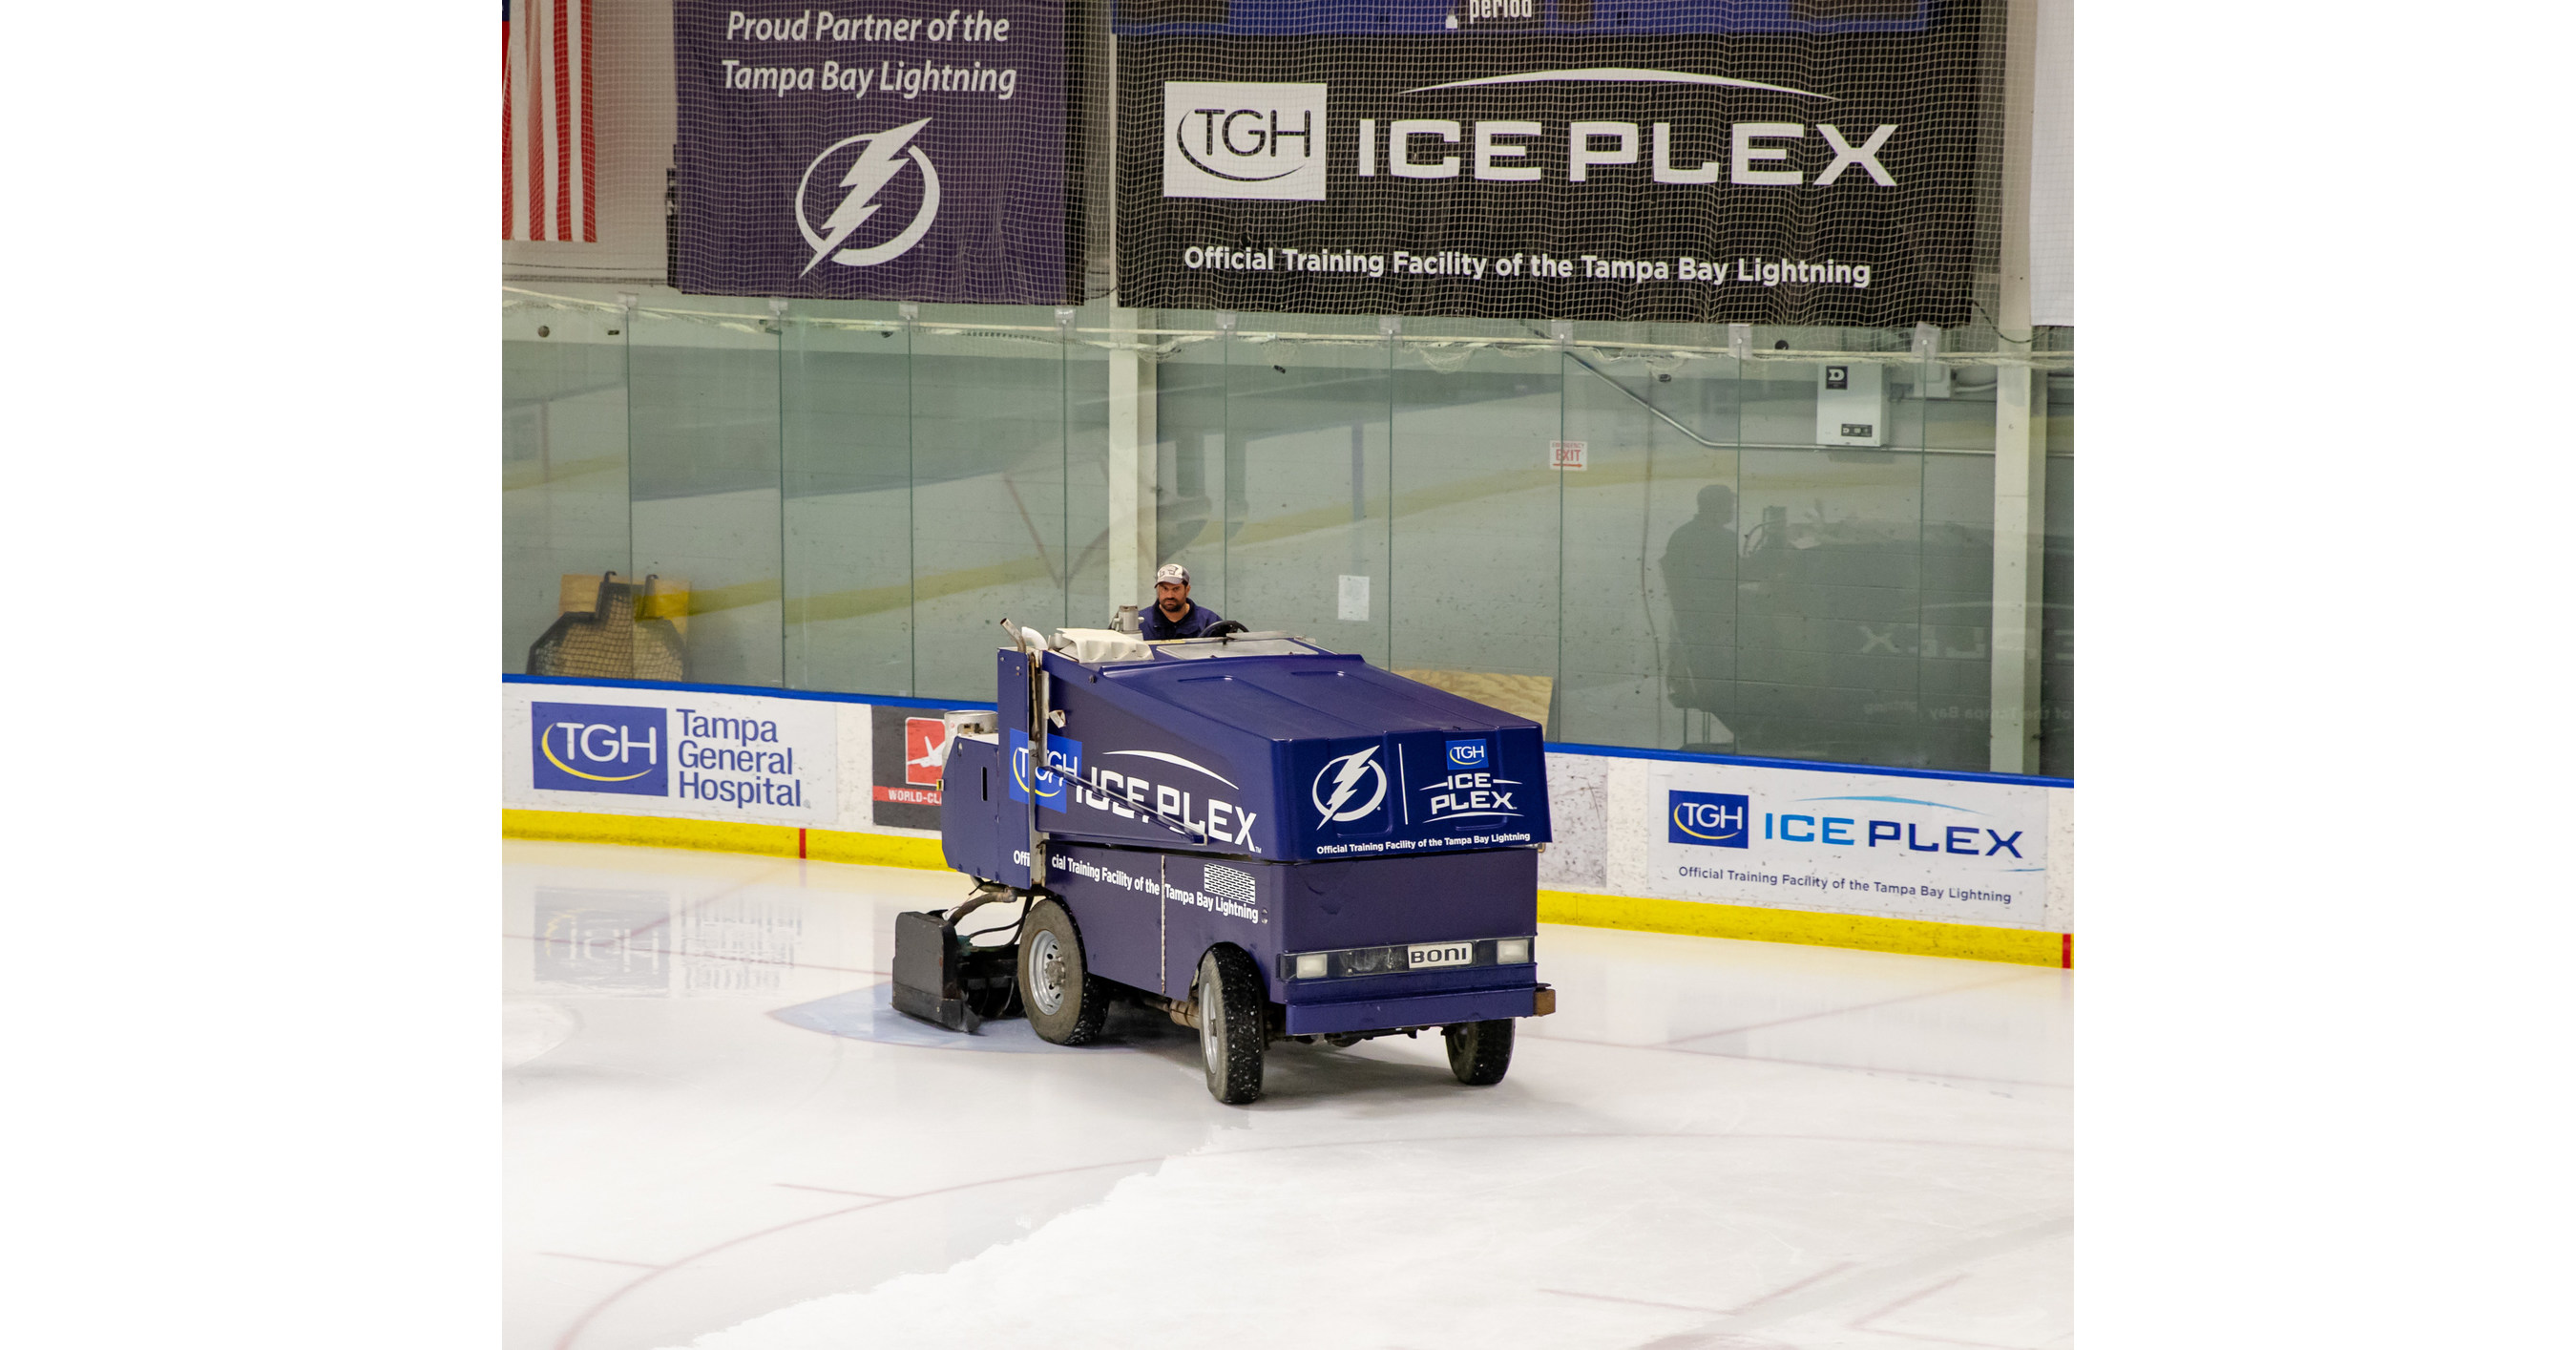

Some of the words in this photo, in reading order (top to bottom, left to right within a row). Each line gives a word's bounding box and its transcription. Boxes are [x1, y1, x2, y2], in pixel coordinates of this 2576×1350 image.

[726, 10, 810, 41] Proud
[815, 11, 922, 41] Partner
[927, 10, 960, 41] of
[963, 10, 1010, 41] the
[722, 59, 815, 97] Tampa
[821, 60, 875, 98] Bay
[879, 59, 1016, 100] Lightning
[1194, 109, 1311, 158] TGH
[1358, 118, 1542, 181] ICE
[1568, 121, 1899, 187] PLEX
[1184, 246, 1274, 270] Official
[1282, 248, 1385, 278] Training
[1393, 251, 1487, 280] Facility
[1495, 252, 1523, 277] of
[1530, 253, 1574, 278] the
[1581, 255, 1669, 284] Tampa
[1678, 257, 1729, 285] Bay
[1737, 258, 1871, 288] Lightning
[1555, 449, 1581, 462] EXIT
[556, 722, 657, 765] TGH
[676, 708, 779, 747] Tampa
[679, 740, 793, 775] General
[1017, 748, 1078, 787] TGH
[1453, 746, 1485, 759] TGH
[680, 770, 801, 809] Hospital
[1447, 772, 1492, 791] ICE
[1431, 791, 1514, 815] PLEX
[1316, 844, 1348, 854] Official
[1349, 842, 1384, 852] Training
[1385, 839, 1416, 850] Facility
[1417, 838, 1427, 848] of
[1428, 838, 1443, 847] the
[1444, 836, 1472, 846] Tampa
[1474, 835, 1490, 845] Bay
[1491, 832, 1531, 843] Lightning
[1682, 802, 1743, 830] TGH
[1765, 812, 1855, 846] ICE
[1868, 819, 2023, 859] PLEX
[1067, 857, 1100, 882] Training
[1101, 867, 1133, 891] Facility
[1134, 875, 1144, 891] of
[1145, 878, 1161, 896] the
[1165, 883, 1195, 905] Tampa
[1196, 891, 1214, 912] Bay
[1215, 896, 1259, 924] Lightning
[1679, 866, 1724, 879] Official
[1728, 870, 1778, 886] Training
[1782, 875, 1828, 890] Facility
[1833, 878, 1845, 889] of
[1850, 879, 1870, 892] the
[1874, 881, 1916, 896] Tampa
[1920, 885, 1944, 899] Bay
[1949, 888, 2012, 905] Lightning
